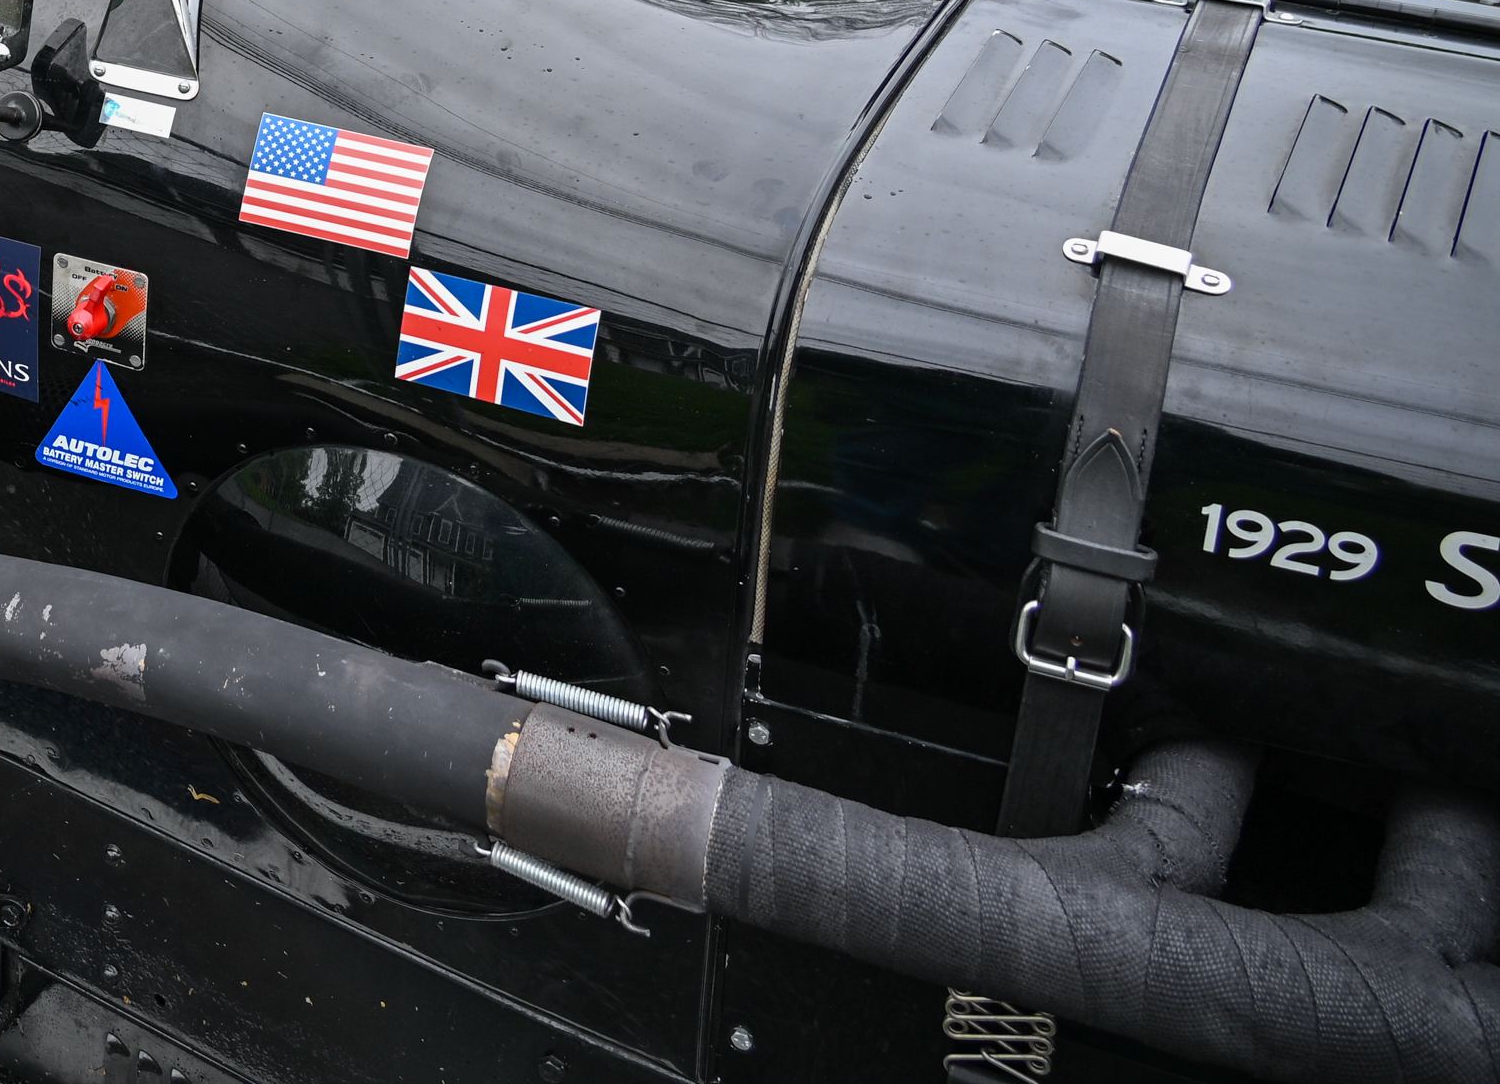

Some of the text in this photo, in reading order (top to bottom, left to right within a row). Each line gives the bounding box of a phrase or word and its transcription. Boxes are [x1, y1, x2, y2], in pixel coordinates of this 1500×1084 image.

[115, 284, 128, 292] ON
[43, 447, 164, 486] BATTERY MASTER SWITCH
[53, 435, 154, 471] AUTOLEC
[47, 458, 66, 466] DIVISION
[73, 465, 99, 475] STANDARD
[99, 471, 117, 480] MOTOR
[117, 476, 143, 487] PRODUCTS
[1200, 502, 1500, 611] 1929 S
